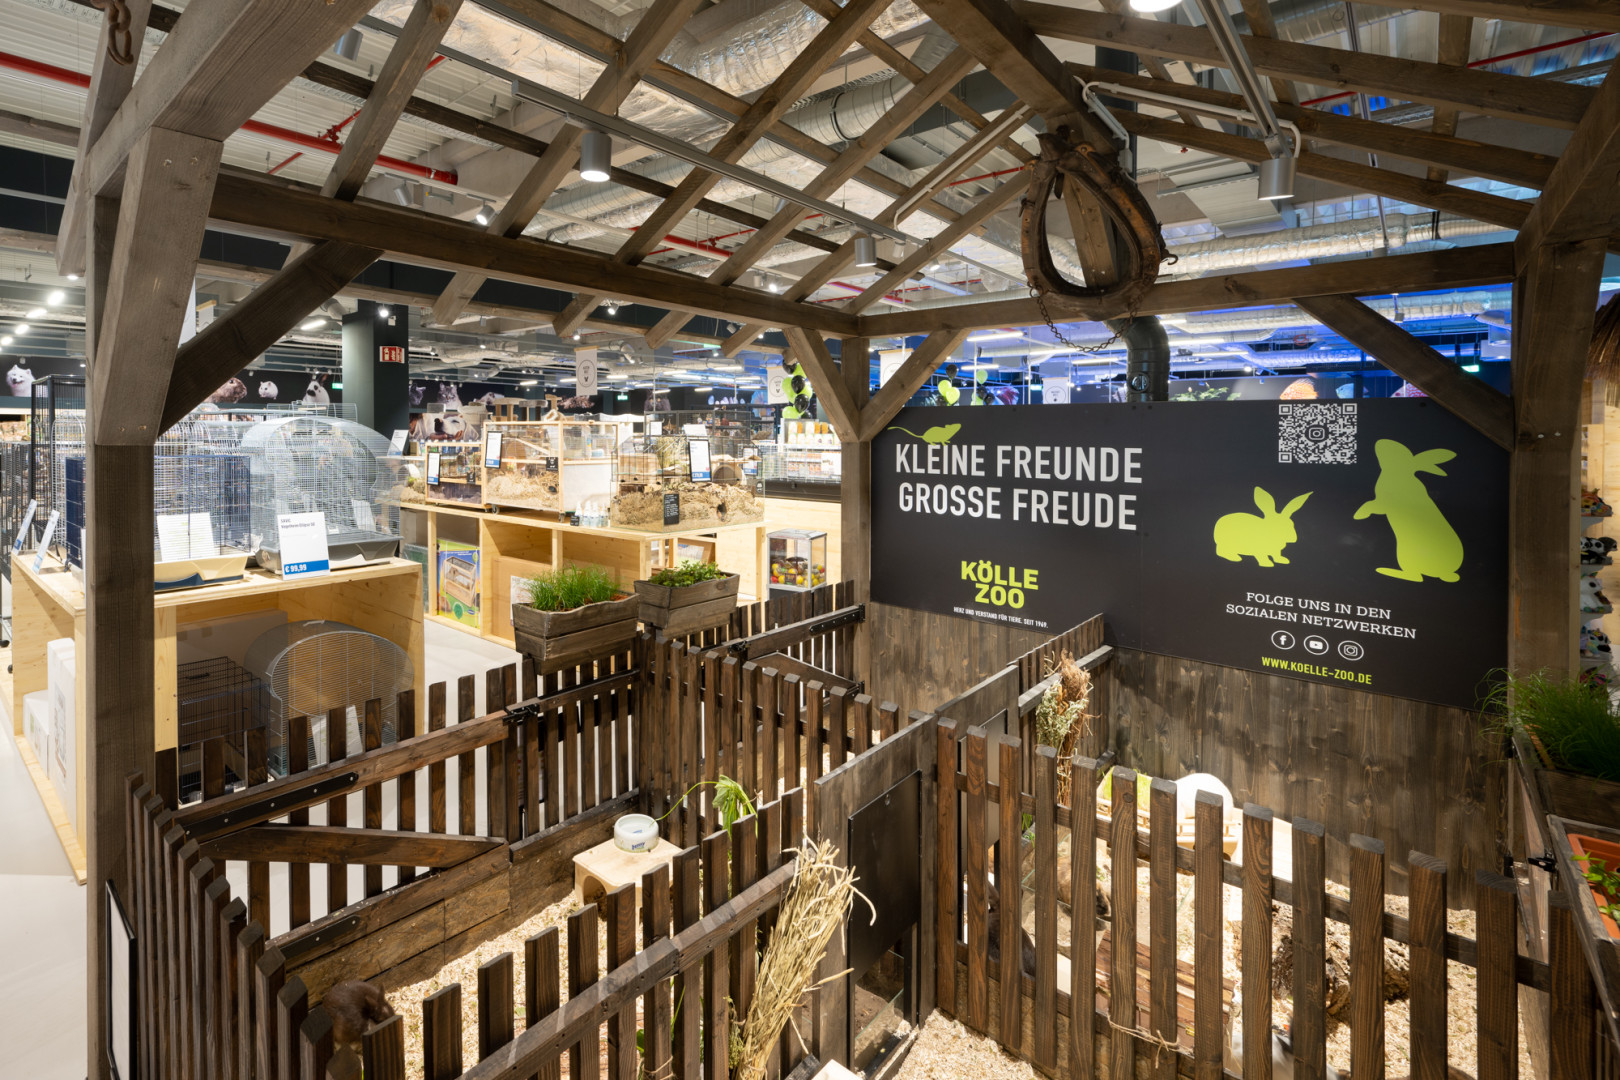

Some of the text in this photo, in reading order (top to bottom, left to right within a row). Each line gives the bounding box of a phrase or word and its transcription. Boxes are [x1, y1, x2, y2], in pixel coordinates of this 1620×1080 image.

[896, 443, 1143, 484] KLEINE FREUNDE
[899, 482, 1138, 531] GROSSE FREUDE
[285, 564, 306, 573] € 99,99
[961, 559, 1039, 591] KÖLLE
[975, 582, 1025, 609] ZOO
[1246, 592, 1392, 620] FOLGE UNS IN DEN
[953, 606, 965, 614] HERZ
[975, 610, 997, 619] VERSTAND
[998, 613, 1008, 622] FÜR
[1008, 615, 1023, 624] TIERE.
[1023, 618, 1034, 626] SEIT
[1225, 603, 1417, 640] SOZIALEN NETZWERKEN
[1261, 656, 1373, 685] WWW.KOELLE-ZOO.DE
